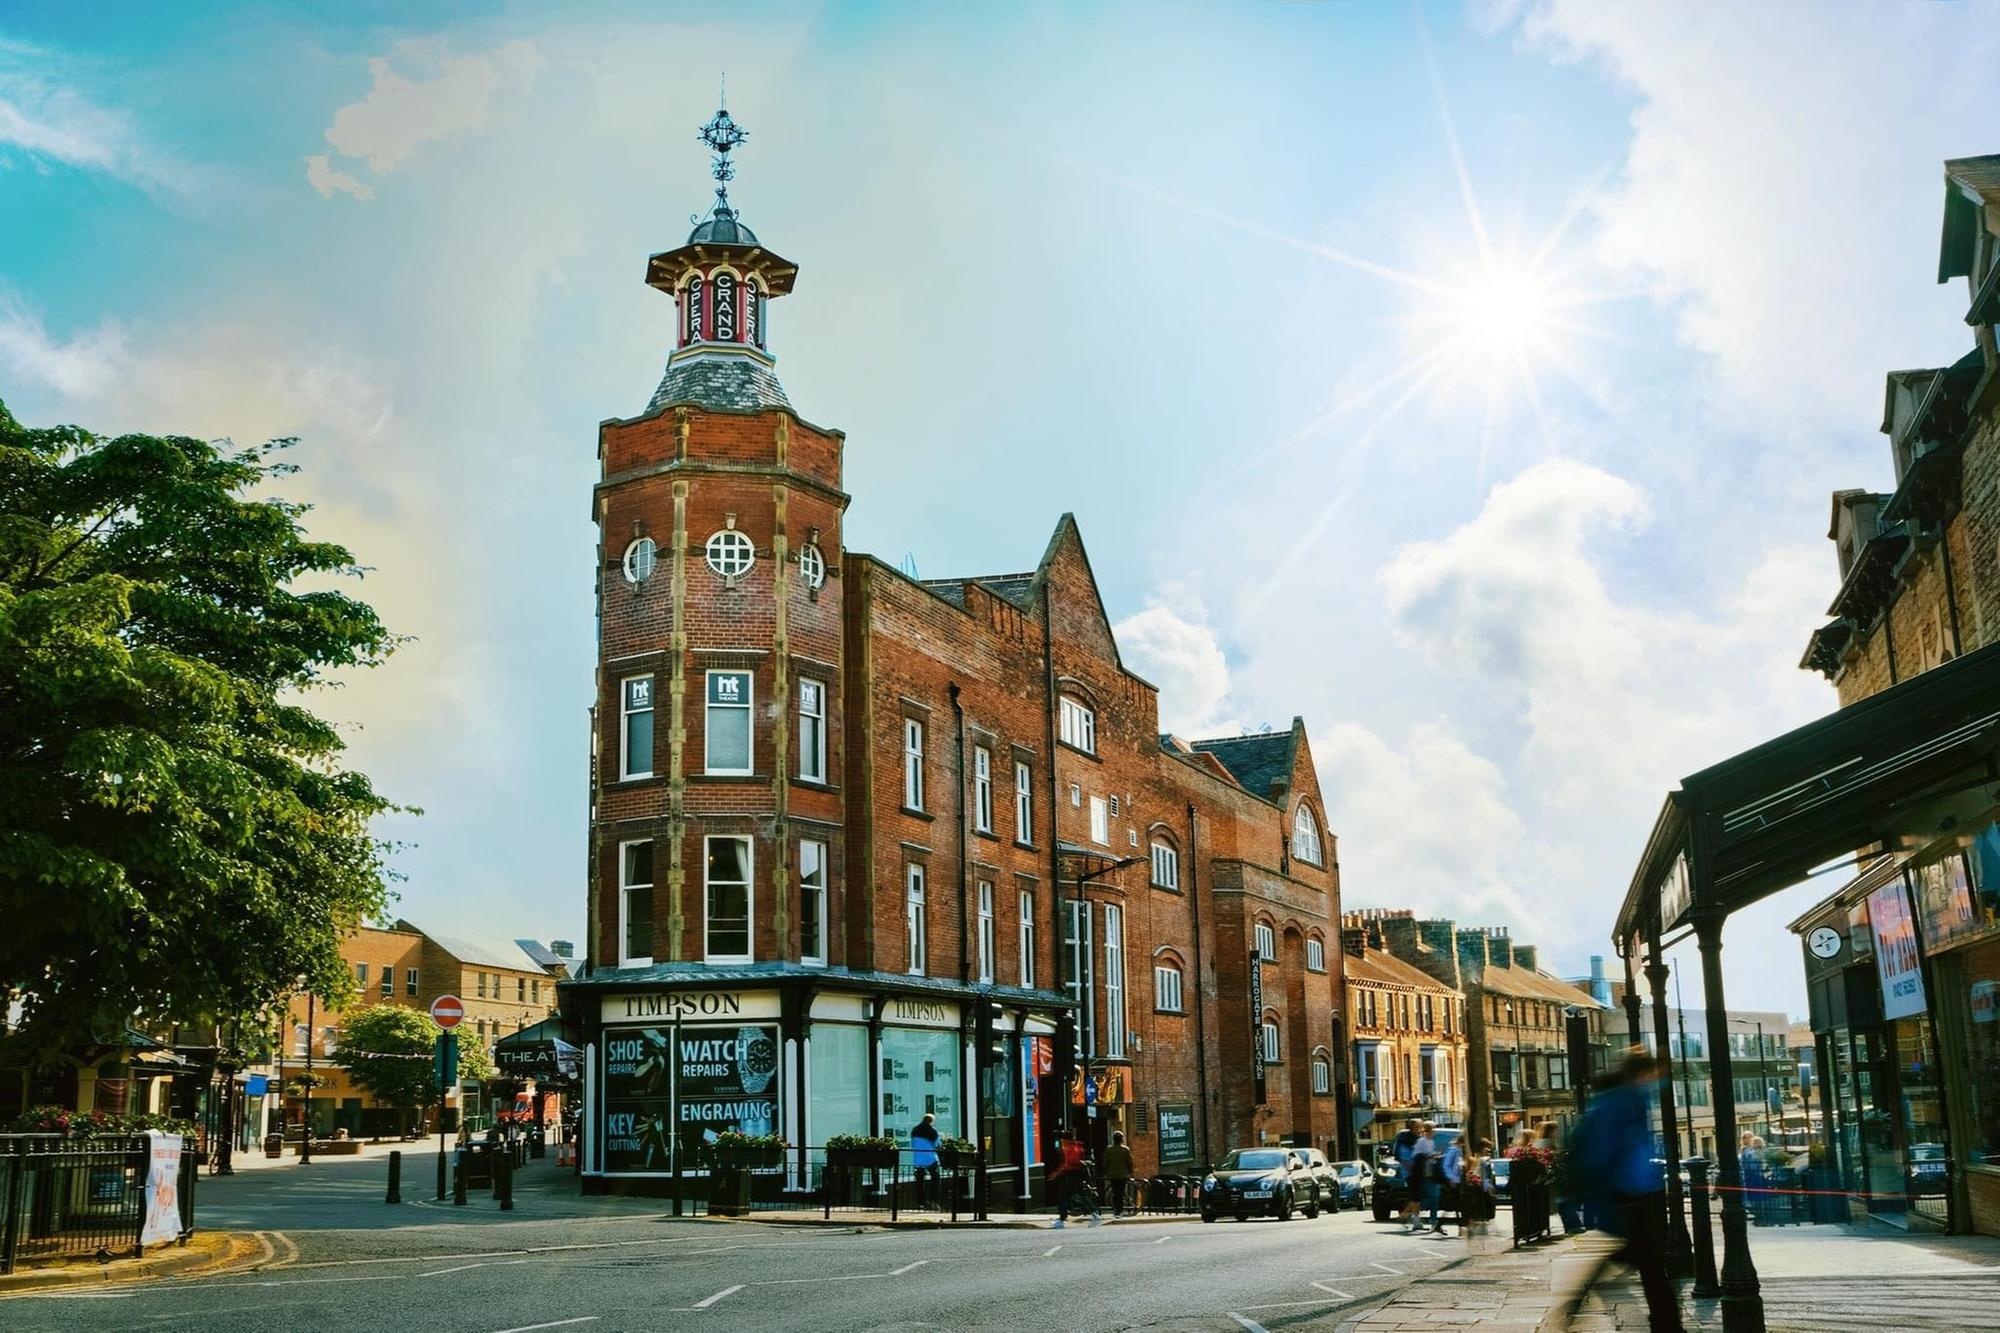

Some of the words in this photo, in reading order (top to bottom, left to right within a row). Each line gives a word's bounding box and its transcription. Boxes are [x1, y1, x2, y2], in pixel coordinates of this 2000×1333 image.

[690, 279, 702, 344] OPERA
[717, 276, 733, 340] GRAND
[746, 281, 757, 346] OPERA
[1252, 958, 1261, 1025] HARROGATE
[623, 992, 742, 1017] TIMPSON
[894, 1001, 945, 1021] TIMPSON
[608, 1040, 644, 1061] SHOE
[680, 1040, 748, 1062] WATCH
[608, 1063, 638, 1075] REPAIRS
[682, 1064, 729, 1077] REPAIRS
[681, 1102, 772, 1121] ENGRAVING
[608, 1113, 636, 1135] KEY
[608, 1139, 641, 1150] CUTTING
